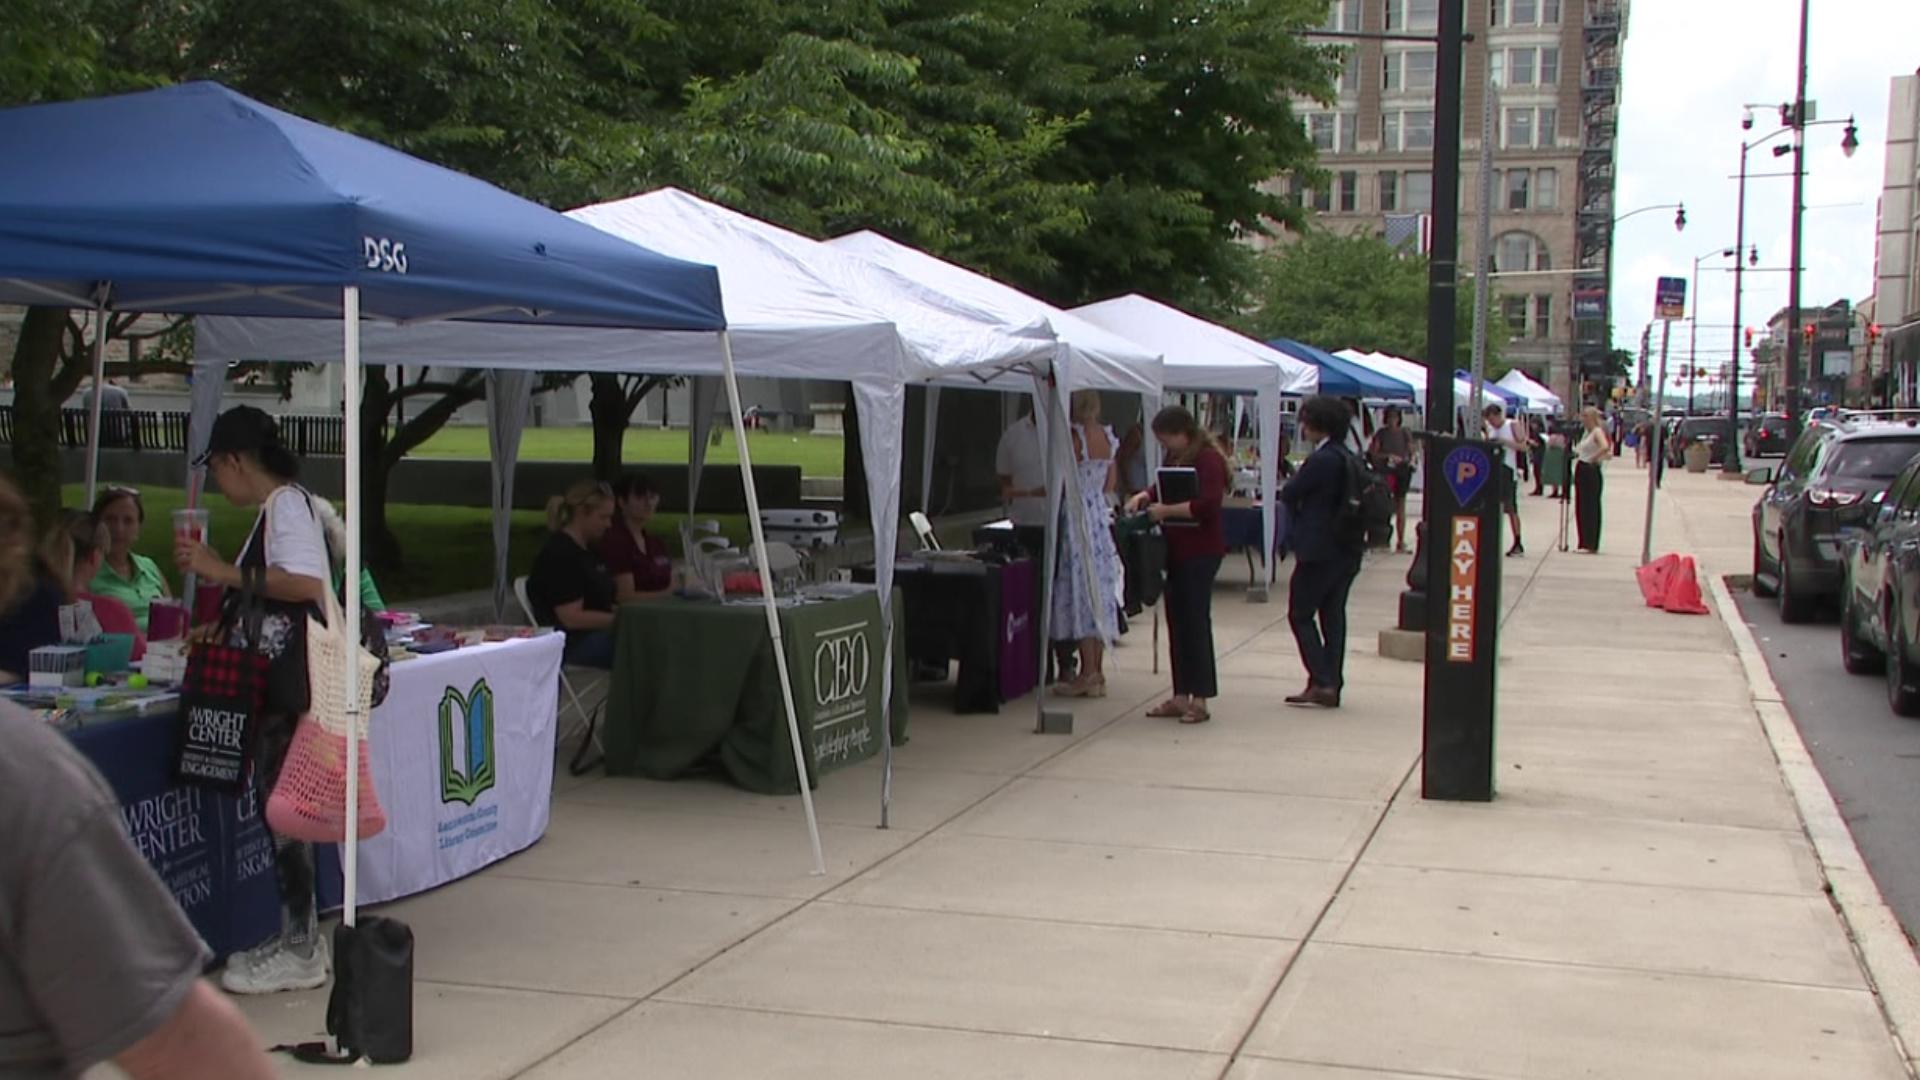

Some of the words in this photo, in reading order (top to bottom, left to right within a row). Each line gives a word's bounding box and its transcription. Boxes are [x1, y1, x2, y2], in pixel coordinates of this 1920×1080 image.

[364, 236, 408, 275] DSG
[1457, 462, 1477, 484] P
[1453, 520, 1476, 575] PAY
[1450, 585, 1473, 658] HERE
[814, 631, 869, 705] CEO
[188, 723, 242, 750] CENTER
[191, 706, 247, 732] WRIGHT
